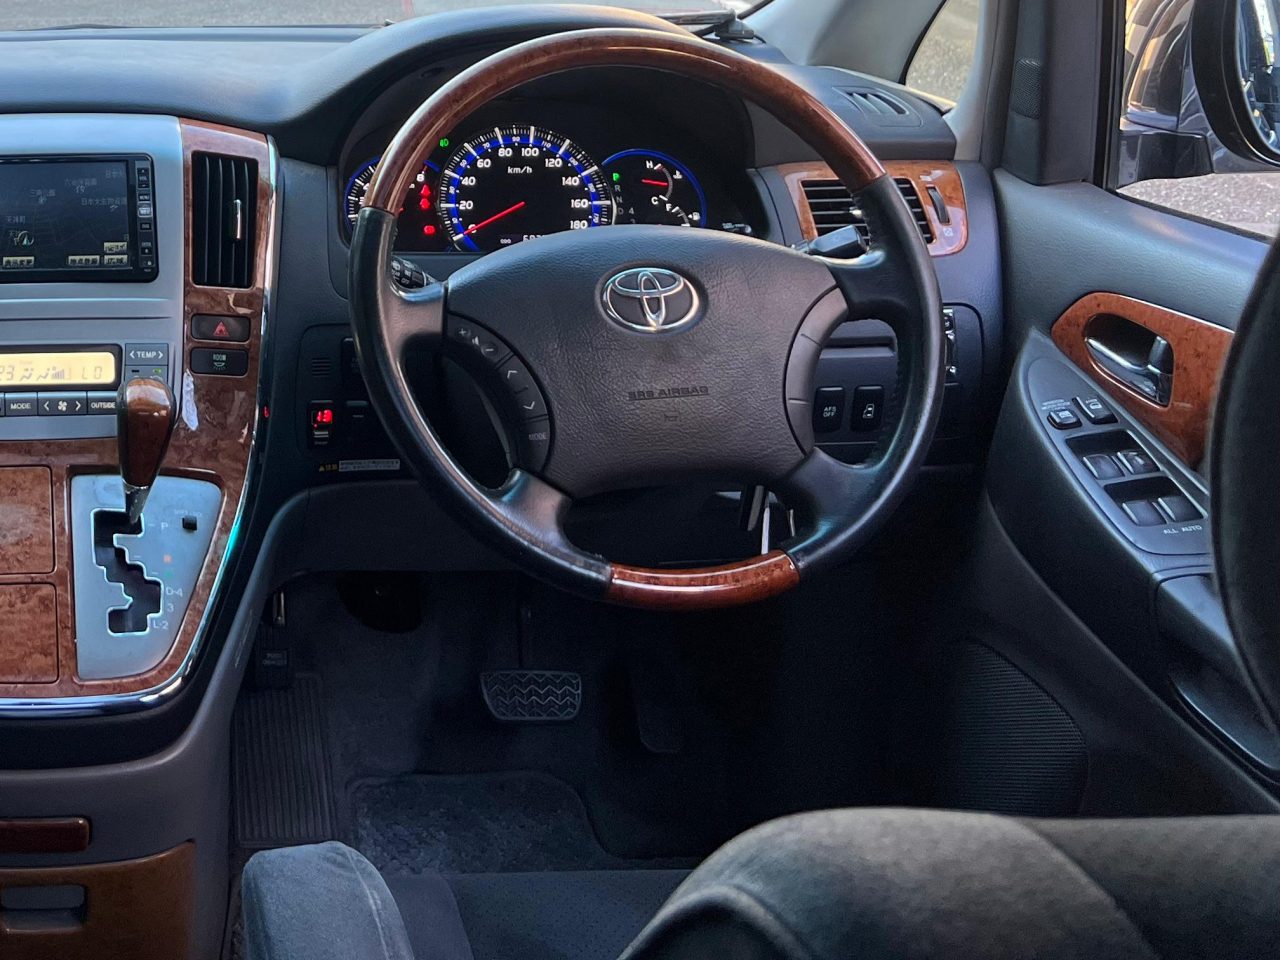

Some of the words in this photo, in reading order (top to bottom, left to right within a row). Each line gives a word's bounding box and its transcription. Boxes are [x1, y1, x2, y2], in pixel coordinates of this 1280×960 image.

[498, 148, 512, 156] 80
[521, 148, 539, 156] 100
[477, 159, 491, 168] 60
[545, 159, 562, 167] 120
[508, 166, 532, 174] km/h
[462, 177, 476, 185] 40
[613, 173, 619, 181] P
[562, 177, 579, 186] 140
[571, 199, 588, 208] 160
[651, 196, 658, 205] C
[459, 201, 473, 210] 20
[666, 203, 672, 211] F
[570, 220, 588, 229] 180
[137, 351, 156, 359] TEMP
[658, 385, 709, 398] AIRBAG
[10, 402, 31, 410] MODE
[91, 401, 115, 409] OUTSIDE
[167, 603, 174, 613] 3
